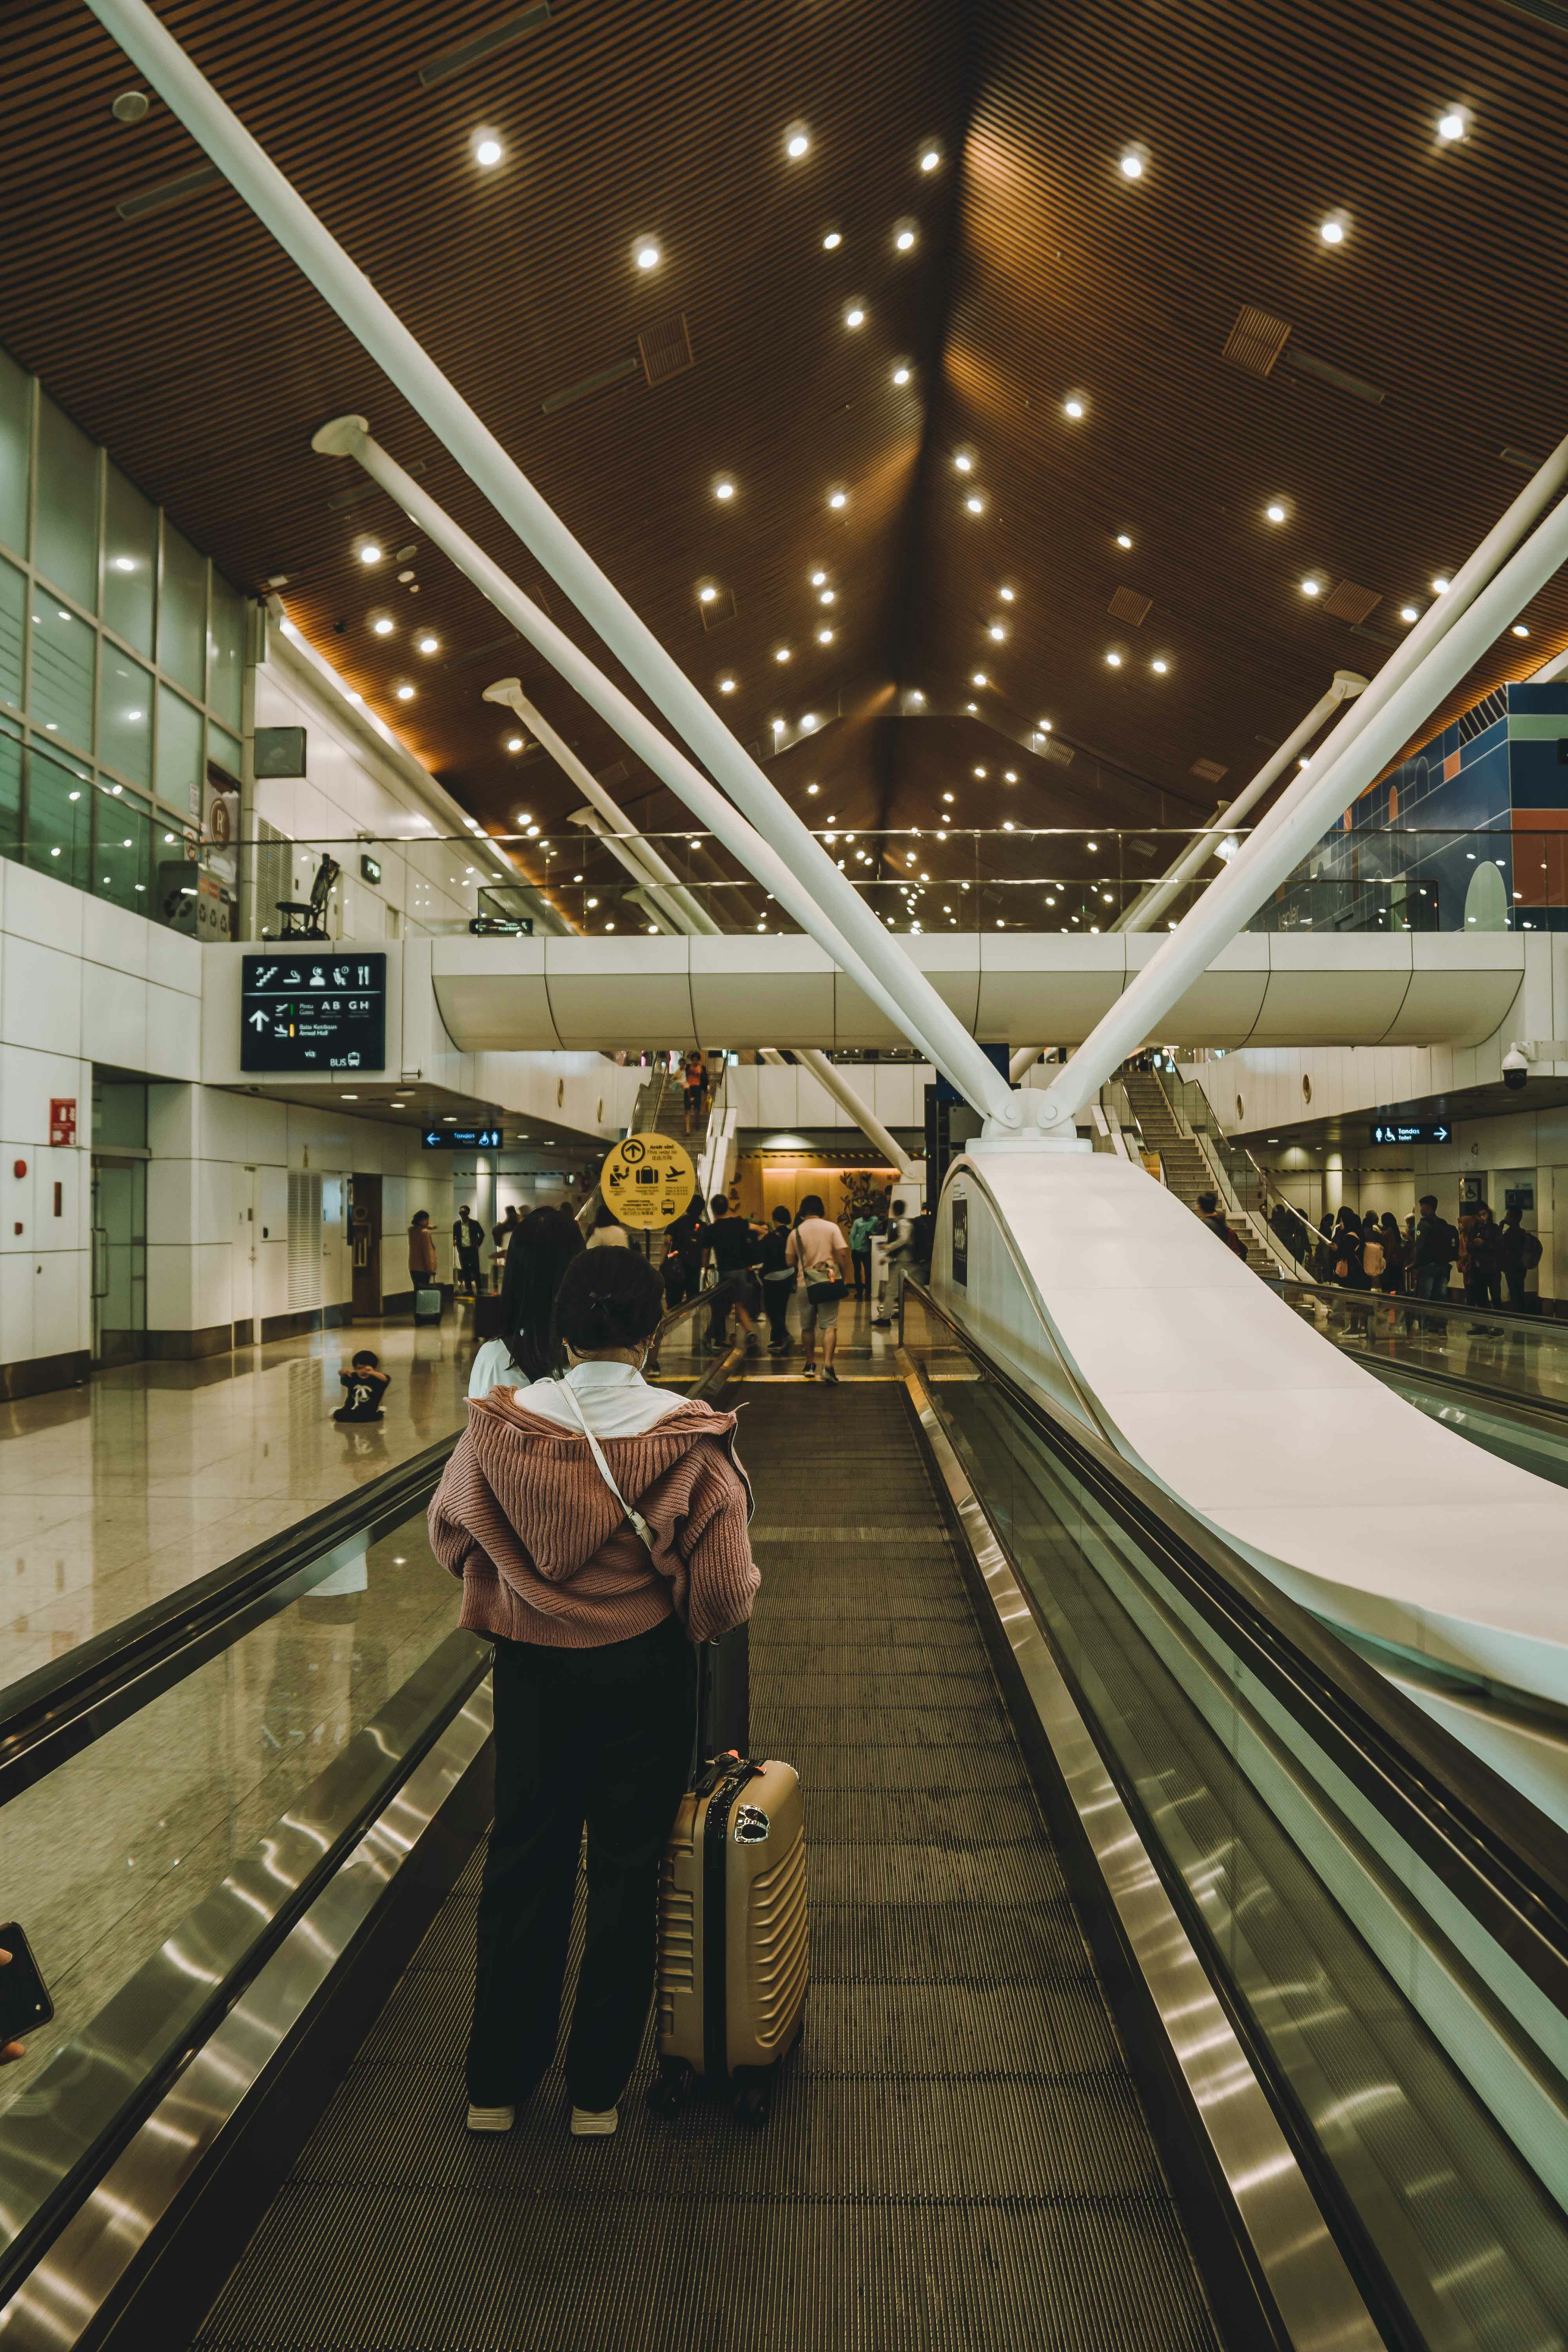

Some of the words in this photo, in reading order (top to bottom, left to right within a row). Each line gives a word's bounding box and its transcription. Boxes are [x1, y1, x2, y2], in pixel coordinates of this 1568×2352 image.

[217, 809, 224, 834] R
[321, 1001, 330, 1010] A
[333, 1001, 340, 1010] B
[348, 1001, 357, 1010] G
[360, 1001, 369, 1010] H
